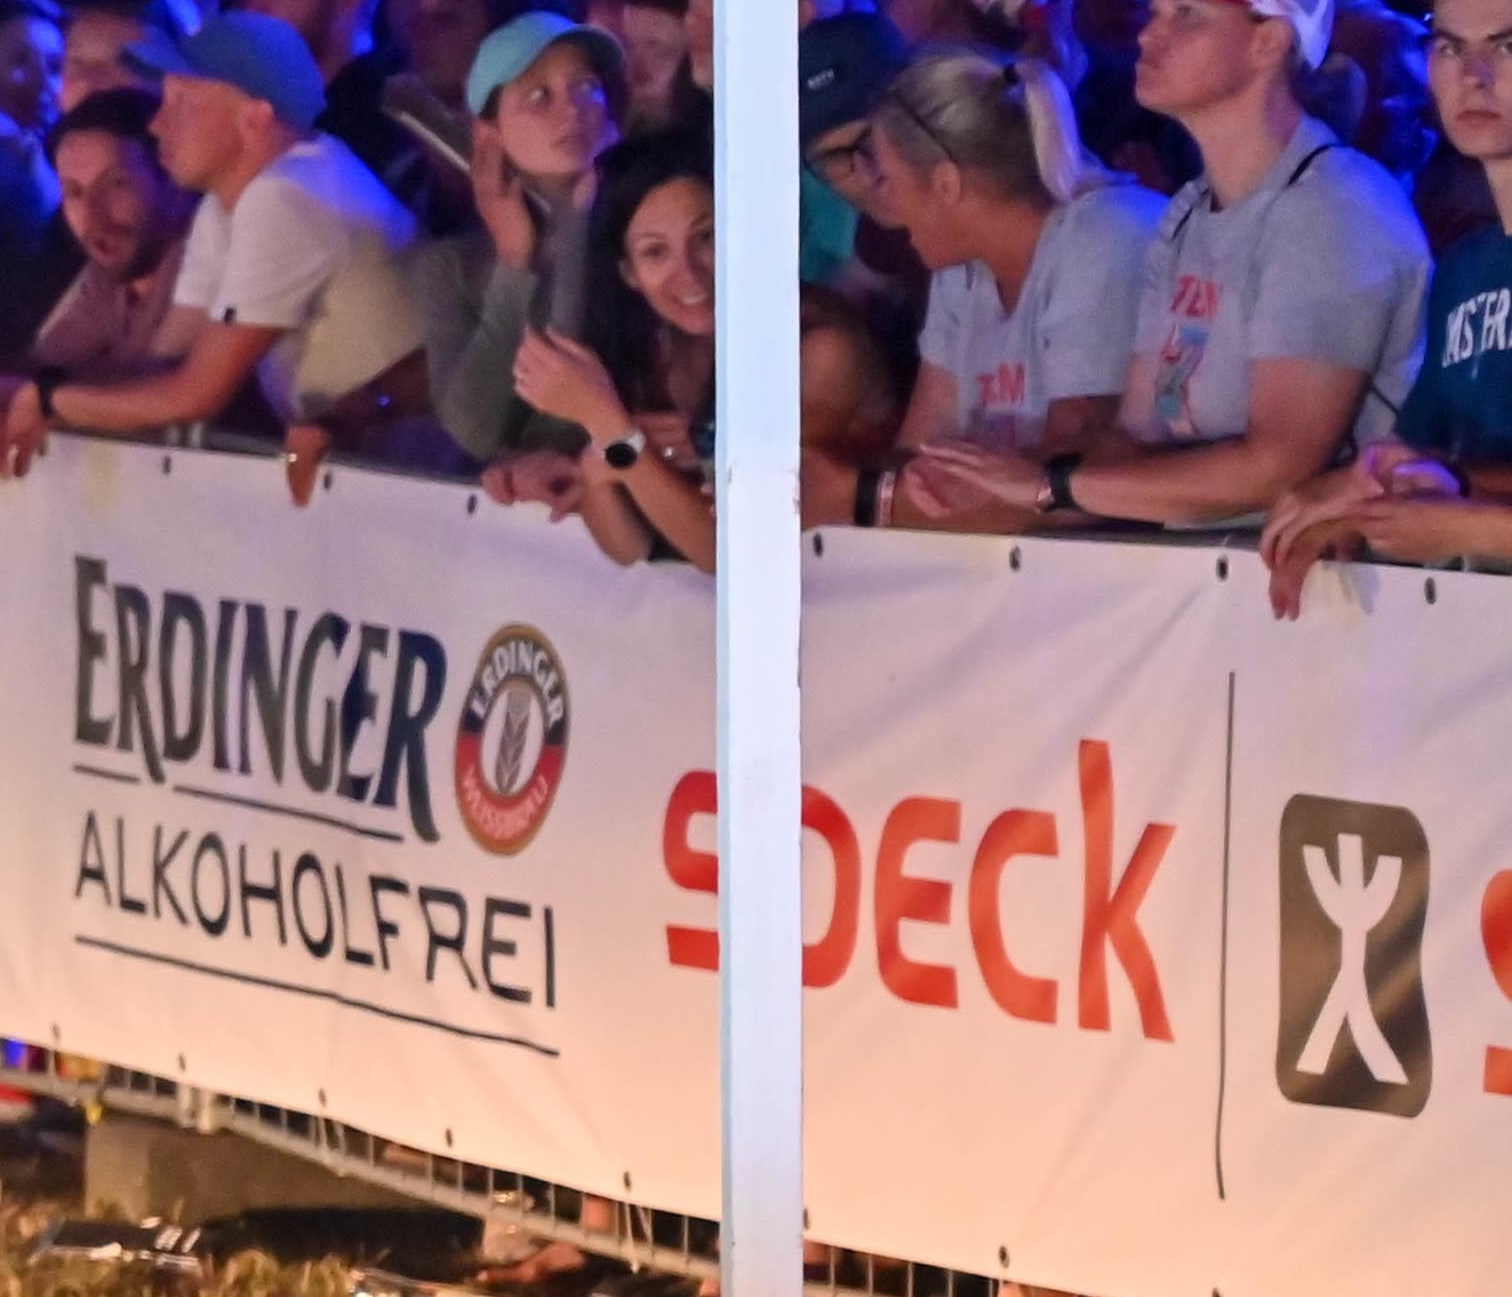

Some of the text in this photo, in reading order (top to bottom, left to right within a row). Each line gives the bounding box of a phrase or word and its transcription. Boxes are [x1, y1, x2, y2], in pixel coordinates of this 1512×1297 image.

[73, 554, 448, 845] ERDINGER
[469, 637, 565, 730] ERDINGER
[73, 807, 558, 1009] ALKOHOLFREI
